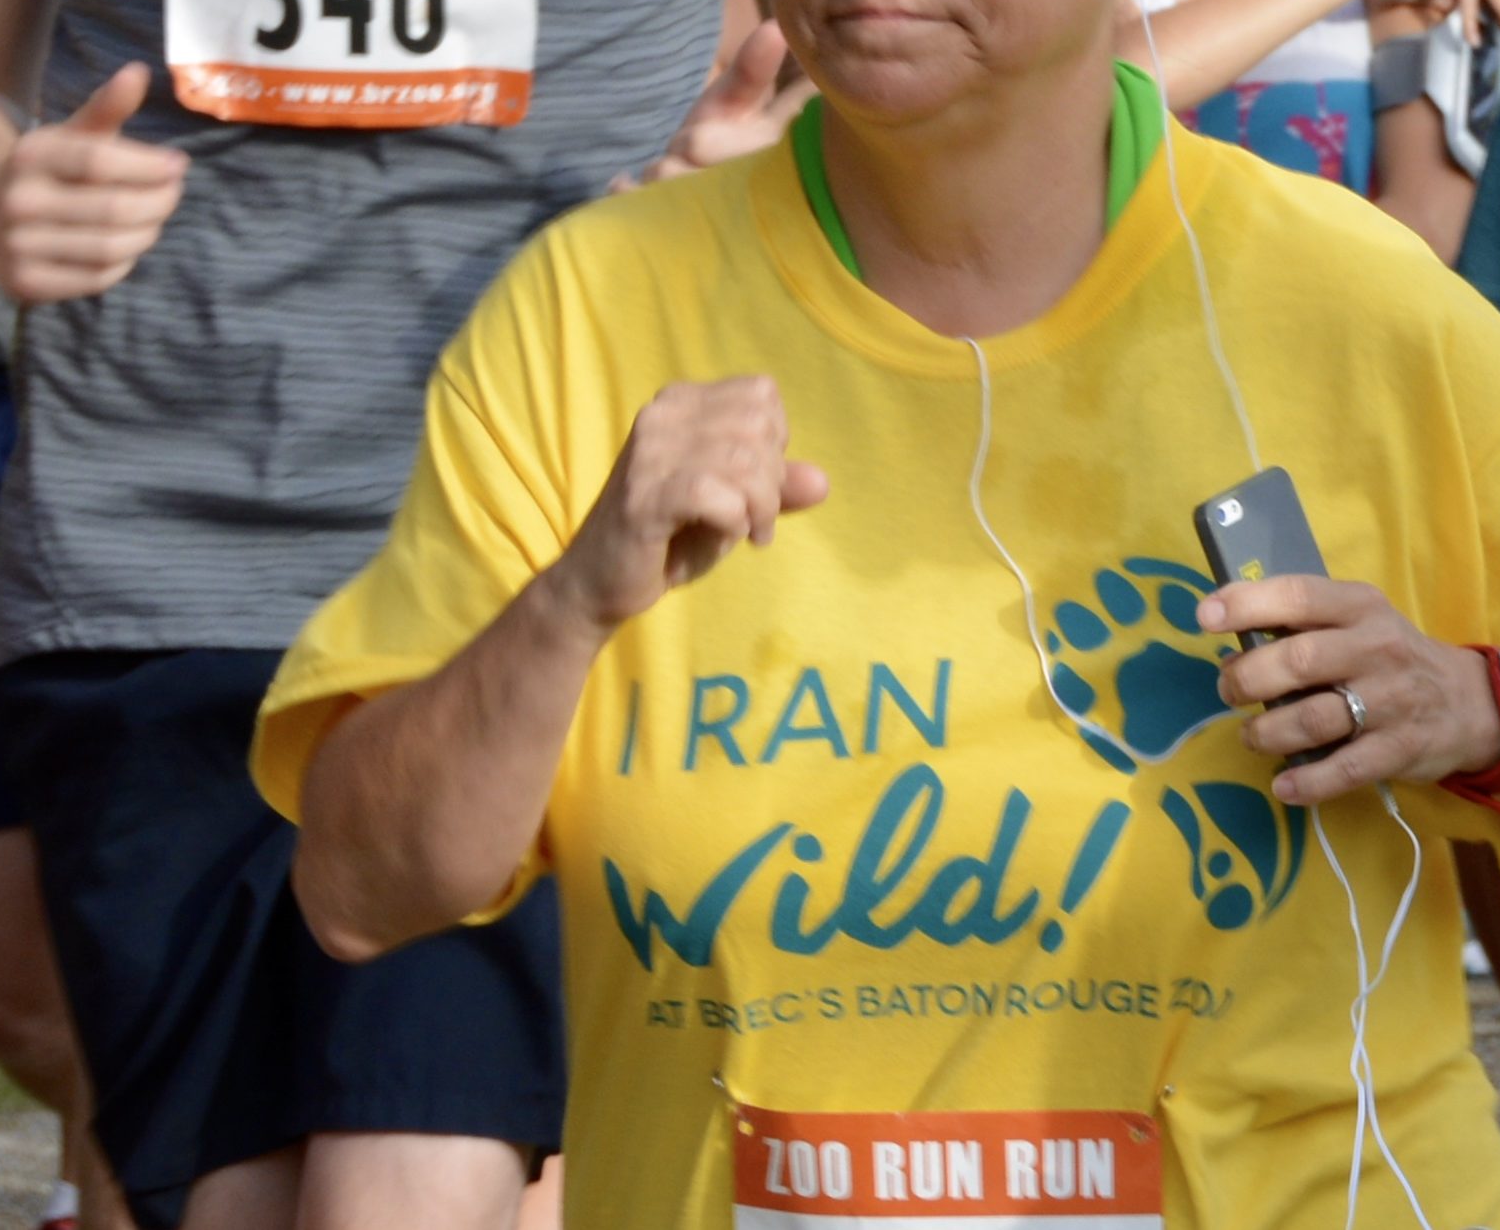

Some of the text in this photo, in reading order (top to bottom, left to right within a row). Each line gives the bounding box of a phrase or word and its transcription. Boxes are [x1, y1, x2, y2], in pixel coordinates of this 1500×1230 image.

[619, 658, 953, 776] I RAN
[603, 762, 1132, 973] Wild!
[647, 998, 687, 1029] AT
[698, 985, 846, 1035] BREC'S
[855, 982, 998, 1019] BATON
[1004, 977, 1160, 1020] ROUGE
[763, 1136, 1116, 1201] ZOO RUN RUN
